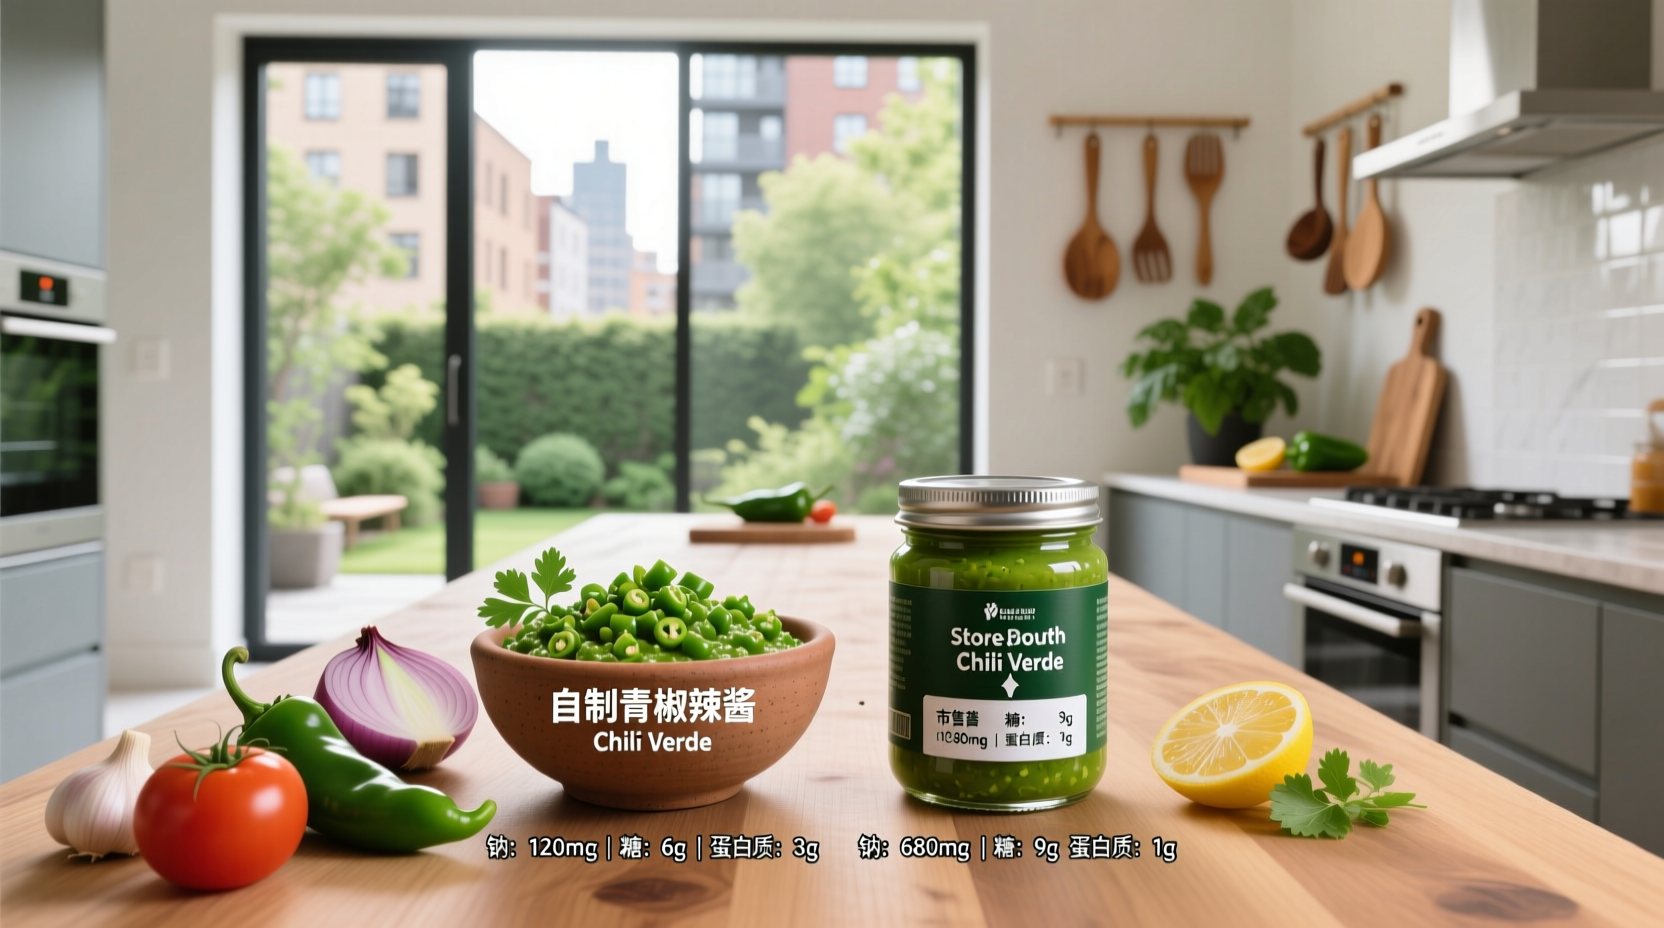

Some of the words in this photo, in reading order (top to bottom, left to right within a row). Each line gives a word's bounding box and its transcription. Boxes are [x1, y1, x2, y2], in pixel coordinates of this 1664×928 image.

[950, 627, 1005, 647] Store
[956, 651, 1003, 672] Chili
[1007, 651, 1064, 672] Verde
[551, 686, 756, 724] 自制青椒辣酱
[593, 730, 642, 752] Chili
[647, 730, 712, 752] Verde
